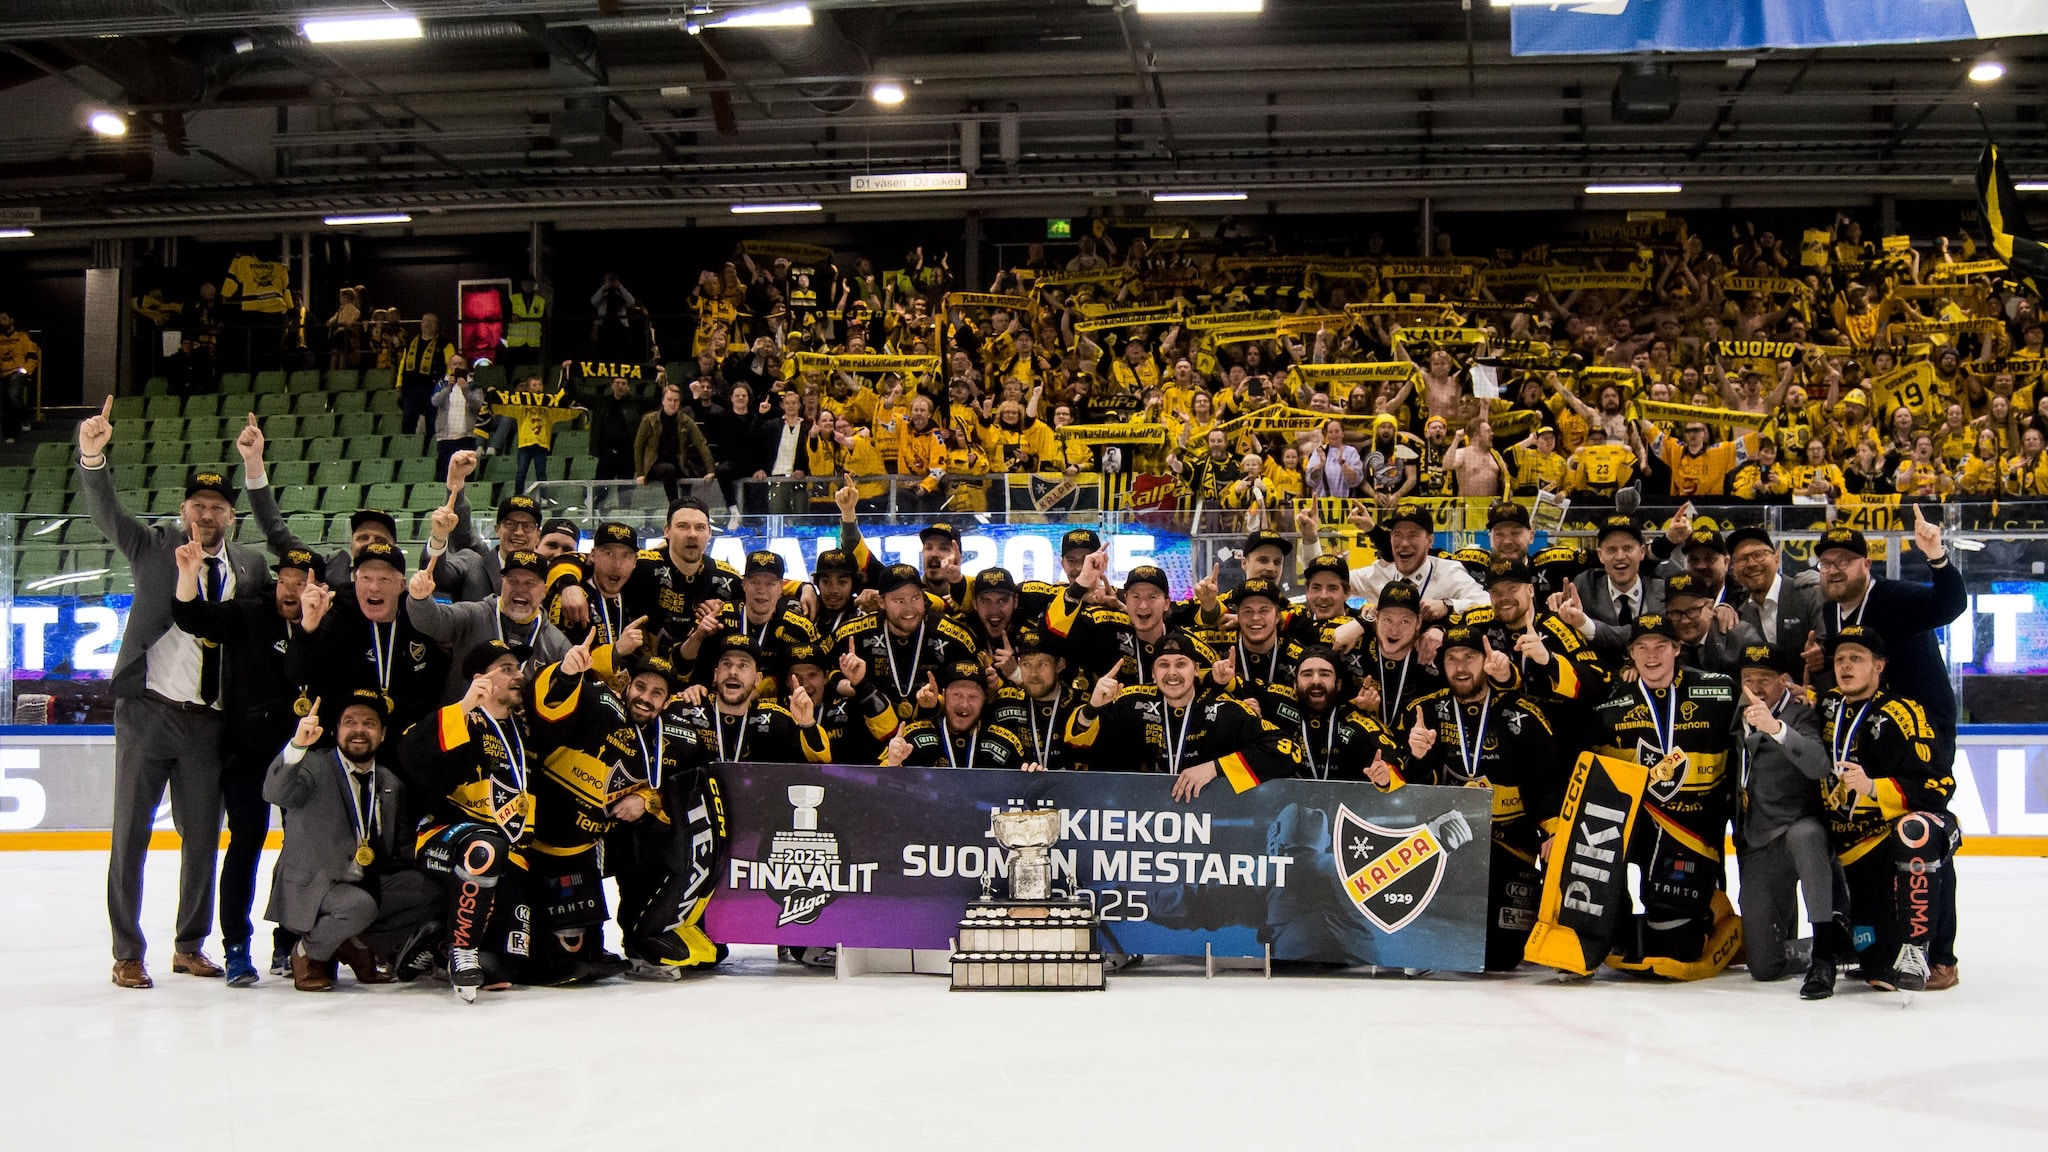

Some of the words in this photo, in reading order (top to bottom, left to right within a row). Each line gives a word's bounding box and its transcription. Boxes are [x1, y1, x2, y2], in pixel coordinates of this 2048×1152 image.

[856, 178, 870, 188] D1
[874, 178, 906, 188] vasen
[1405, 329, 1464, 341] KALPA
[1718, 340, 1796, 358] KUOPIO
[581, 361, 642, 380] KALPA
[497, 388, 566, 407] KALPA
[1087, 395, 1138, 410] KalPa
[1893, 382, 1925, 408] 19
[1266, 418, 1310, 428] PLAYOFFS
[1596, 464, 1609, 475] 23
[1037, 481, 1072, 510] KALPA
[1117, 481, 1190, 511] KalPa
[1852, 506, 1888, 531] 40
[937, 618, 976, 654] PONSSE
[1198, 630, 1237, 644] ONSSE
[1543, 616, 1580, 653] PONSSE
[1267, 683, 1297, 701] PONS
[1692, 688, 1730, 697] KEITELE
[1135, 700, 1161, 716] BOX
[1280, 705, 1302, 720] KEIT
[664, 724, 698, 741] KEITELE
[570, 764, 603, 790] KUOPIO
[1562, 761, 1588, 823] CCM
[709, 777, 728, 838] CCM
[984, 798, 1212, 846] JKIEKON
[664, 801, 716, 933] TEAM
[784, 849, 827, 865] 2025
[902, 844, 1078, 881] SUOMN
[1092, 850, 1295, 889] MESTARIT
[1353, 836, 1432, 897] KALPA
[1563, 801, 1627, 917] PIKI
[730, 858, 880, 893] FINAALIT
[1383, 892, 1415, 905] 1929
[1653, 882, 1700, 899] TAHTO
[1909, 856, 1930, 939] OSUMA
[452, 880, 481, 948] OSUMA
[548, 899, 596, 916] TAHTO
[776, 892, 831, 929] Liiga
[1050, 888, 1150, 923] 025
[1712, 926, 1742, 967] CCM
